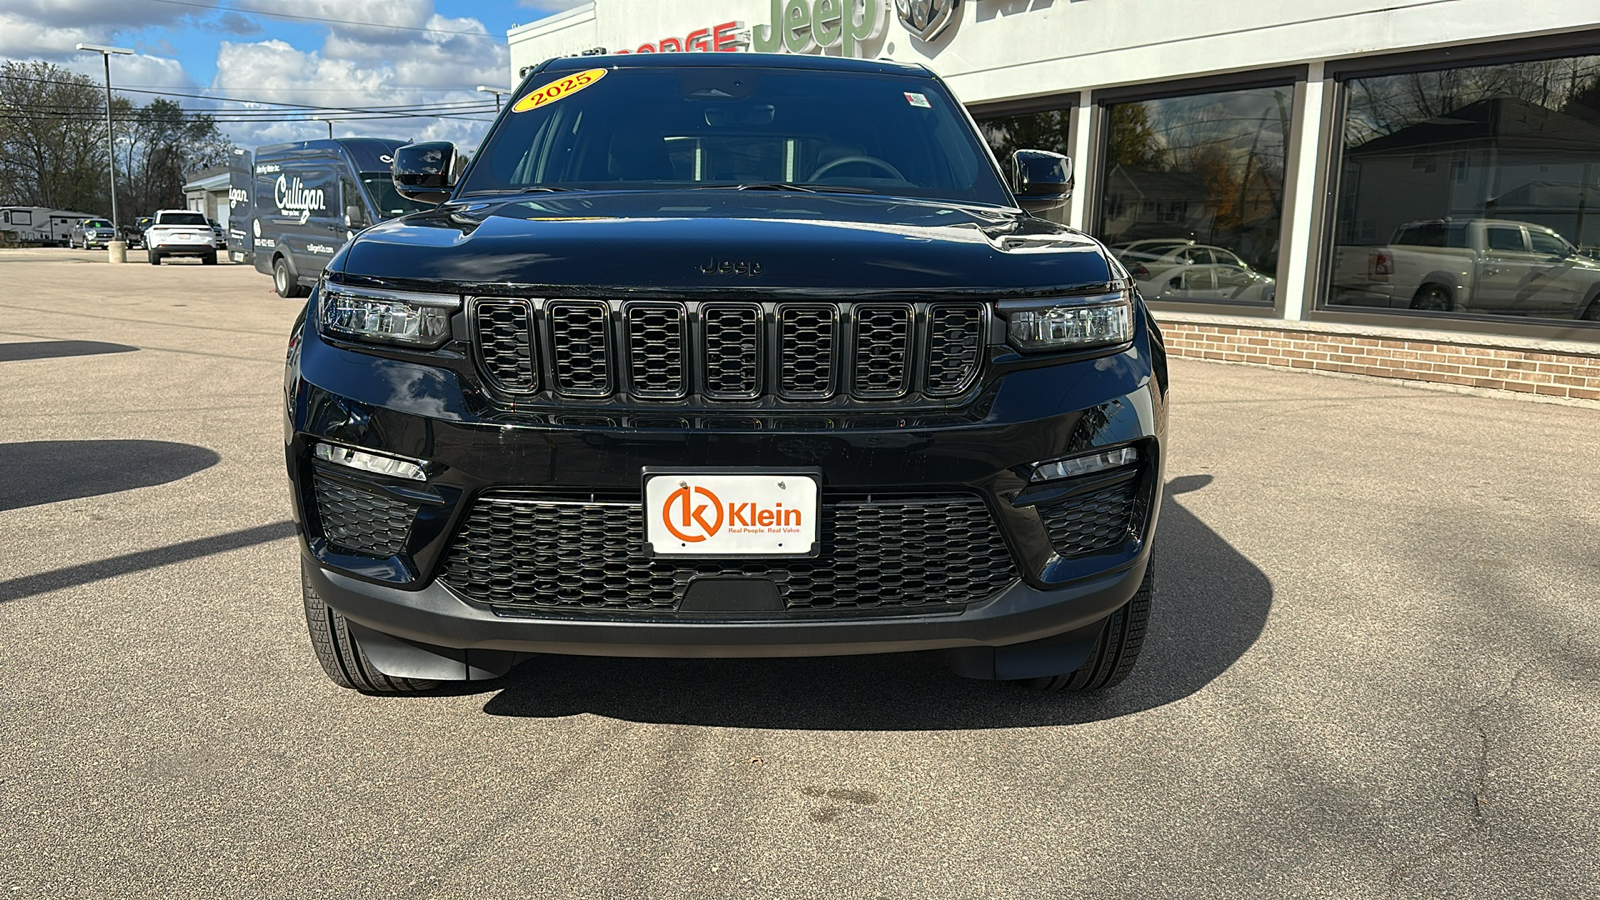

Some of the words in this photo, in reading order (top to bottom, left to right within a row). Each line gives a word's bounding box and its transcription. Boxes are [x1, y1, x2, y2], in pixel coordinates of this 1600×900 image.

[615, 20, 737, 53] DGE
[752, 0, 878, 58] Jeep
[530, 72, 592, 106] 2025
[700, 257, 765, 277] Jeep
[728, 502, 802, 527] Klein
